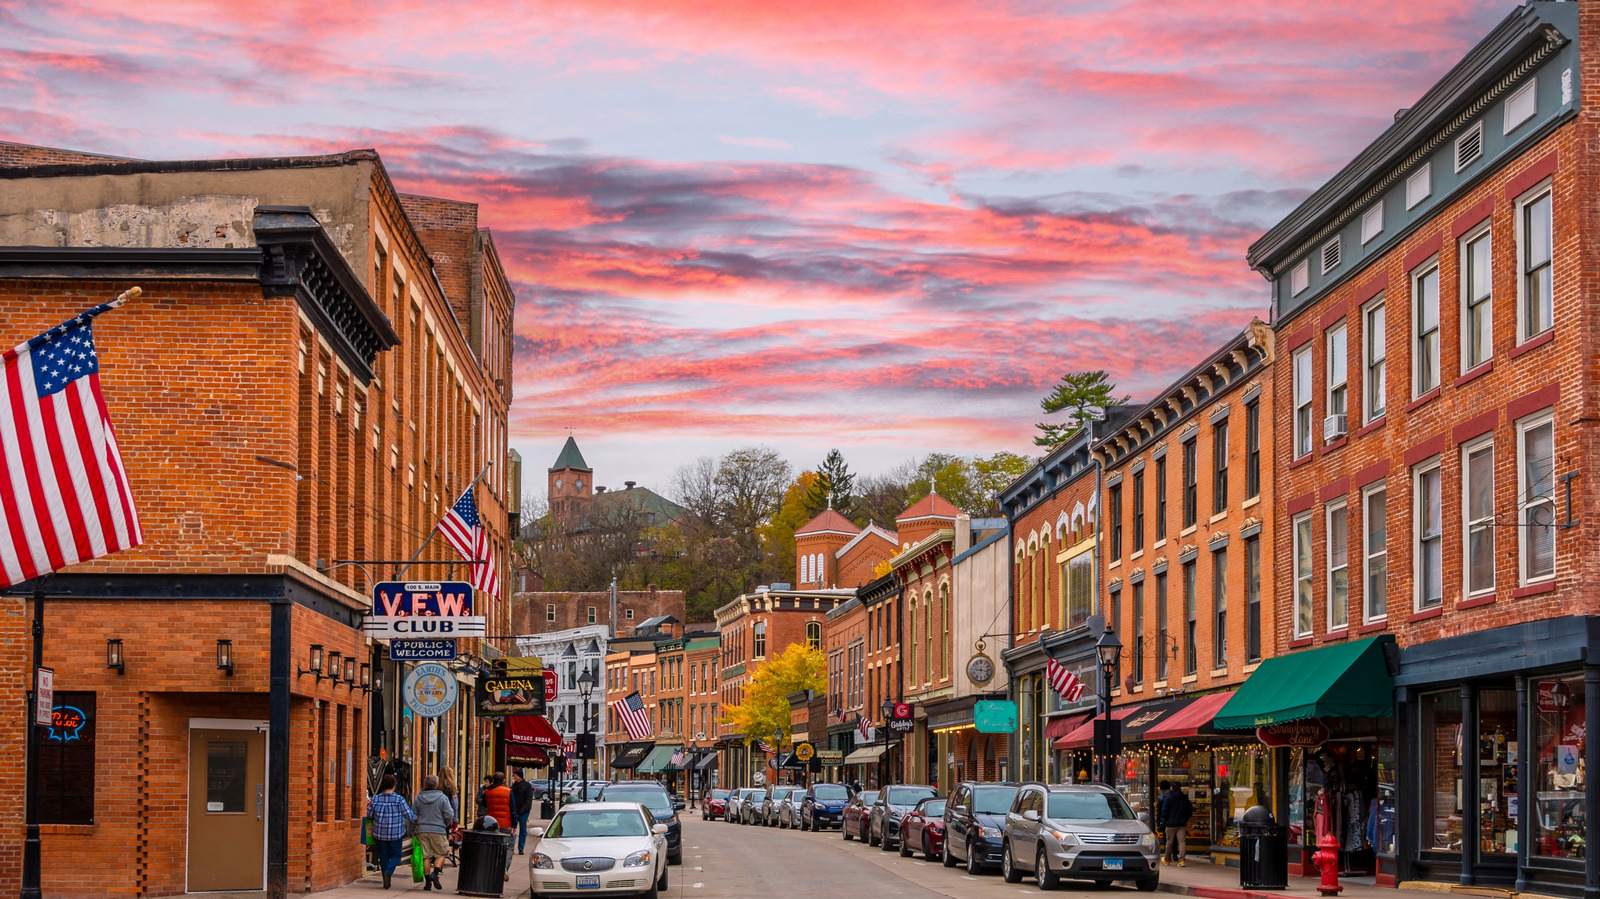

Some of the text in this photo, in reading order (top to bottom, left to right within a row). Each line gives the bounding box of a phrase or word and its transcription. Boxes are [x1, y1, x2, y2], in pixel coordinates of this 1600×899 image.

[393, 620, 454, 633] CLUB
[402, 641, 444, 649] PUBLIC
[395, 649, 451, 657] WELCOME
[415, 665, 447, 677] EARTH'S
[484, 680, 535, 693] GALENA
[409, 697, 451, 715] TREASURES
[1268, 721, 1320, 739] Strawberry
[1289, 731, 1315, 745] Lane
